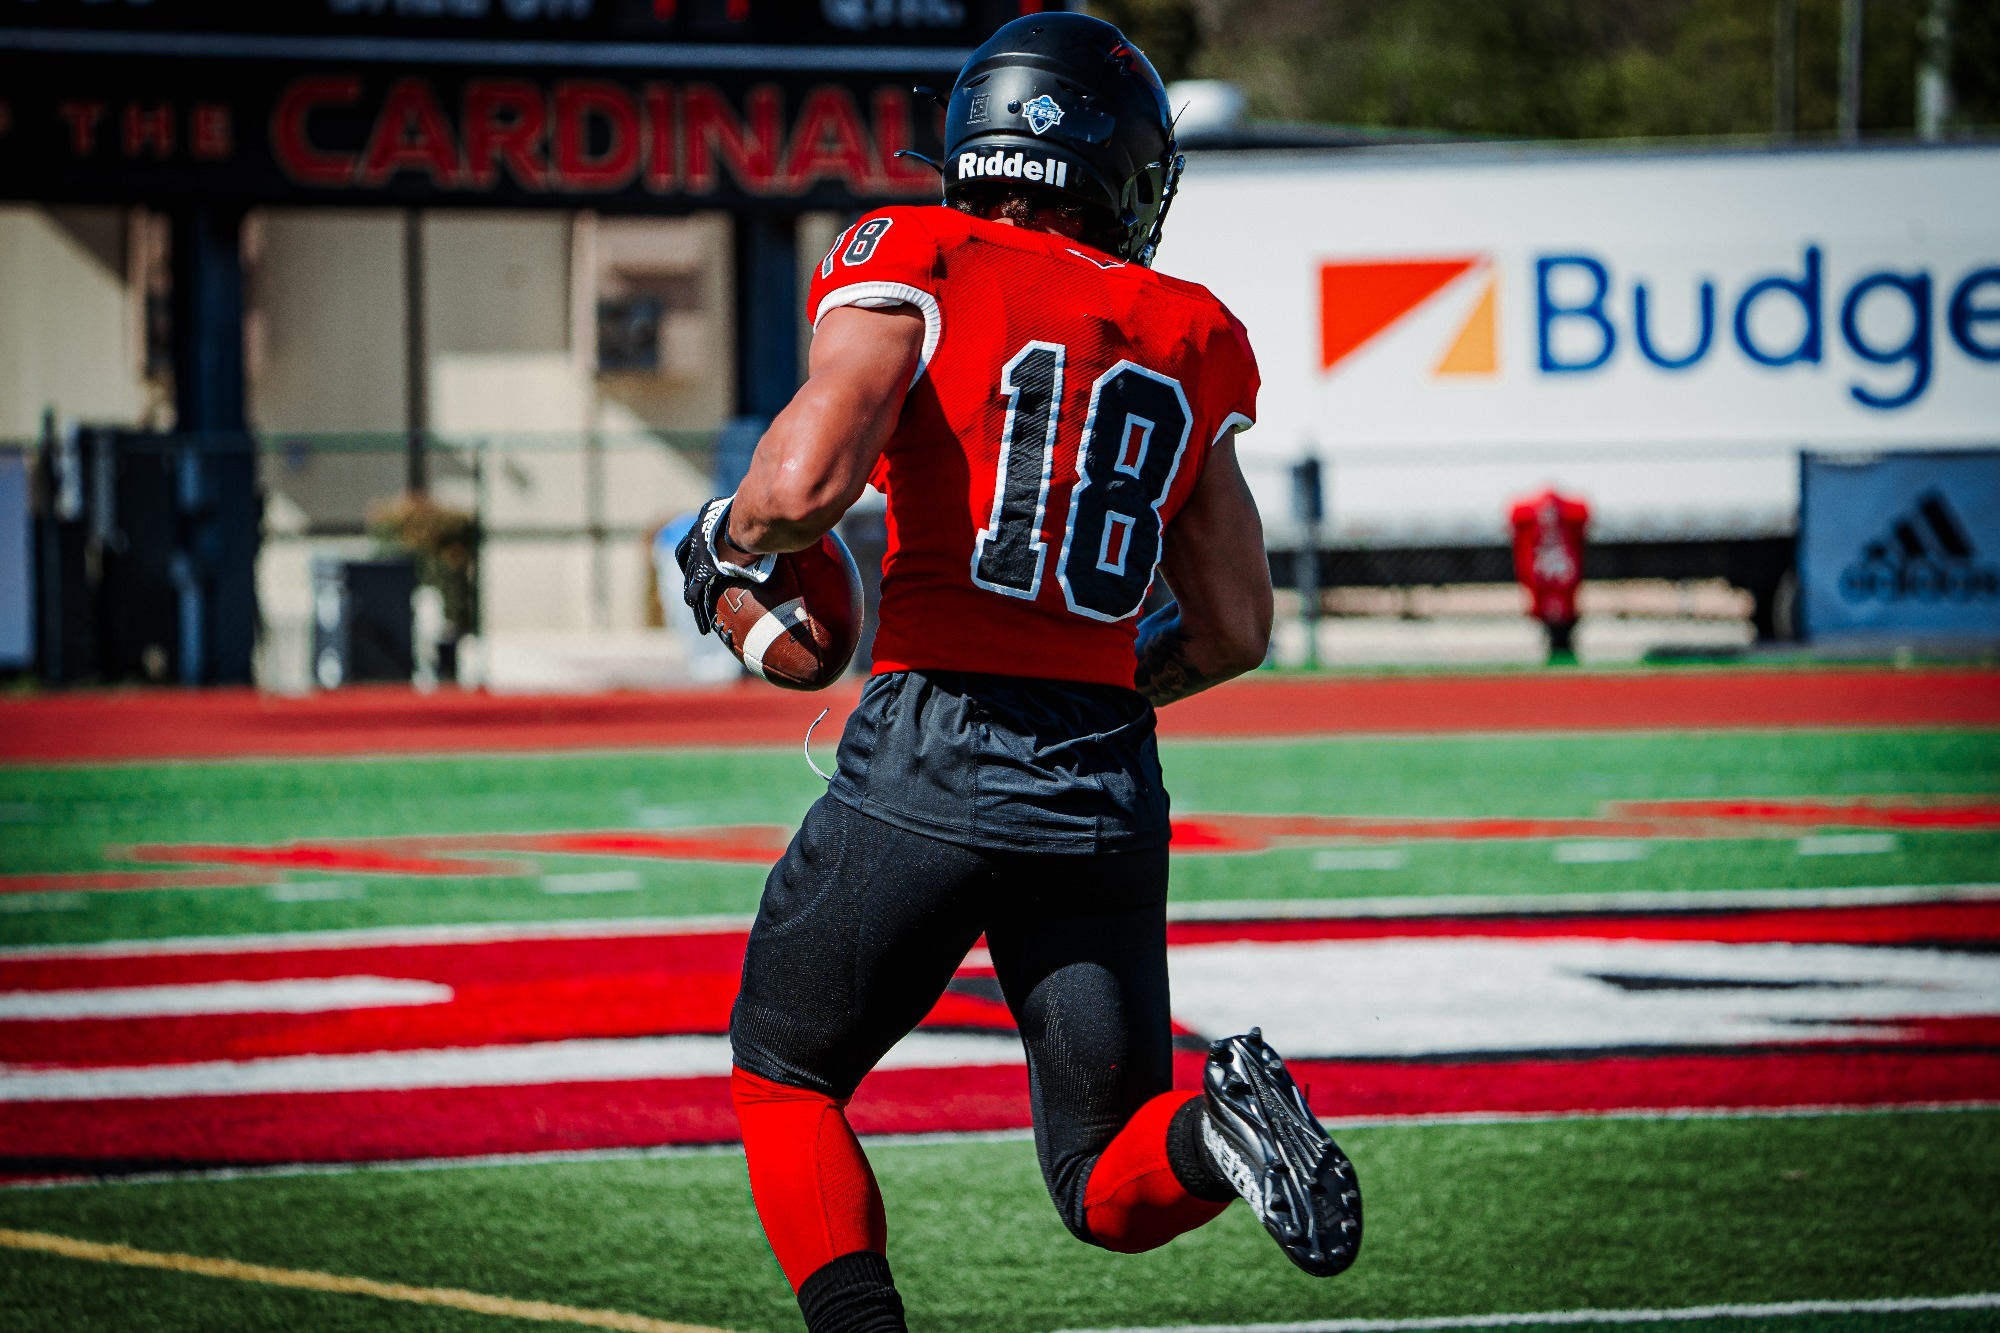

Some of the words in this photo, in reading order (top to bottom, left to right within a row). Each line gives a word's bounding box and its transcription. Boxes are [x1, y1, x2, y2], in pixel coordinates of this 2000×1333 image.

[59, 100, 234, 158] THE
[270, 76, 944, 194] CARDINAL
[958, 150, 1068, 188] Riddell
[822, 217, 894, 279] 18
[970, 339, 1194, 623] 18
